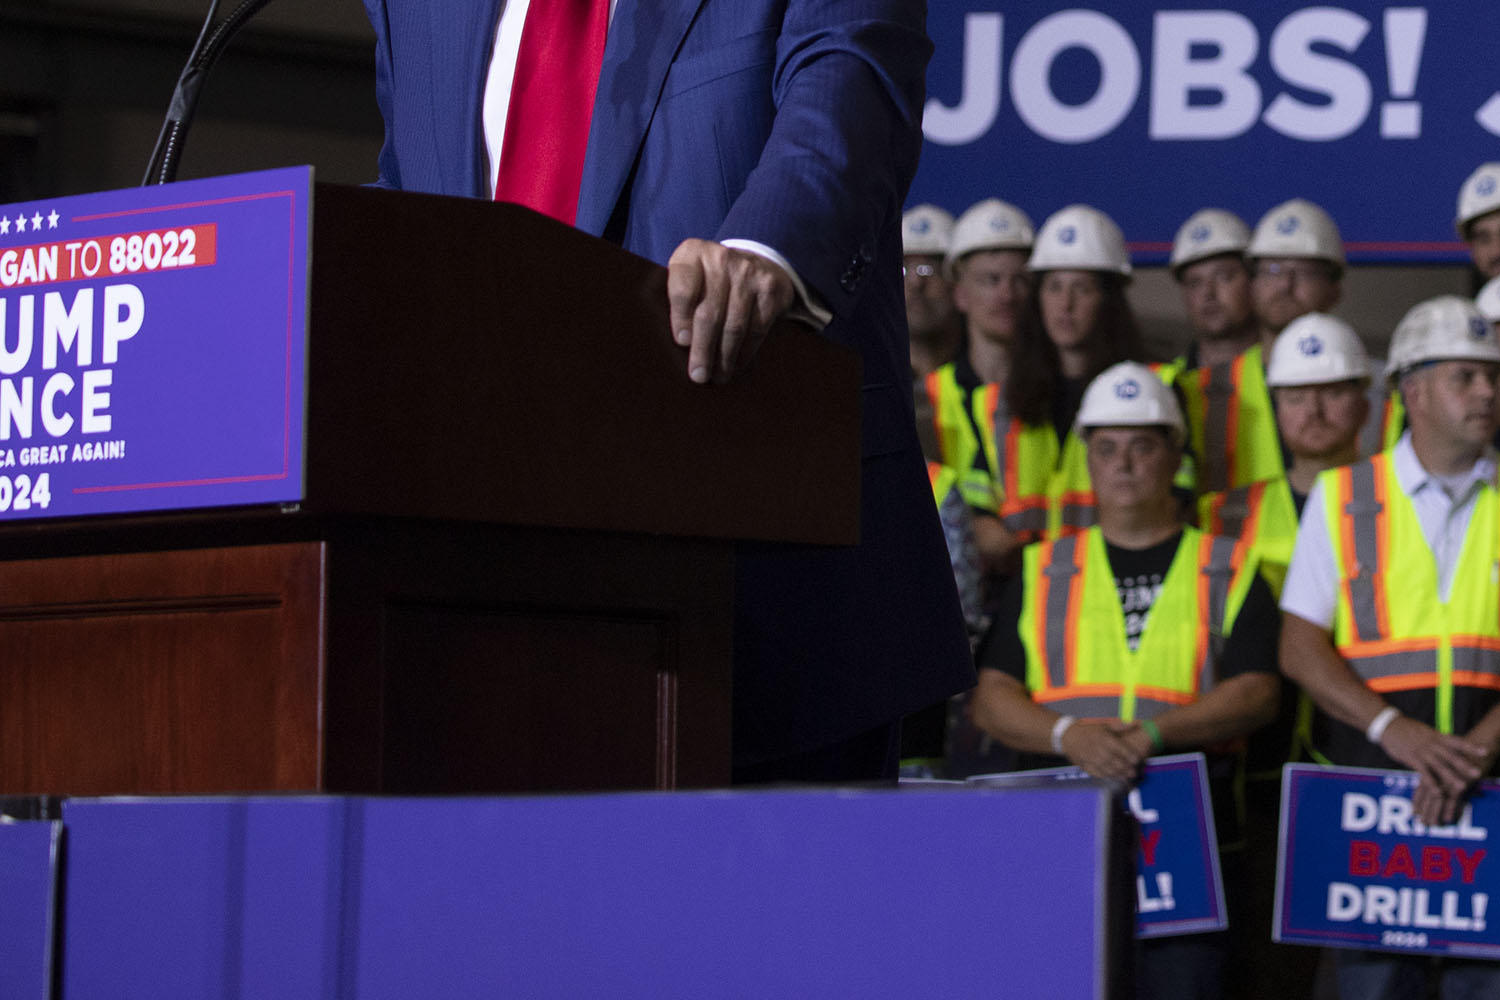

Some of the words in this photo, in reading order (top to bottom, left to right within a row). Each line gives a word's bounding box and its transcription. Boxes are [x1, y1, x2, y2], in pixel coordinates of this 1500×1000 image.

[923, 7, 1427, 146] JOBS!
[0, 245, 59, 286] GAN
[65, 240, 102, 277] TO
[109, 228, 196, 274] 88022
[0, 284, 145, 374] UMP
[0, 369, 113, 440] NCE
[20, 444, 69, 466] GREAT
[72, 440, 126, 462] AGAIN!
[0, 472, 51, 512] 024
[1349, 840, 1487, 884] BABY
[1326, 882, 1489, 932] DRILL!
